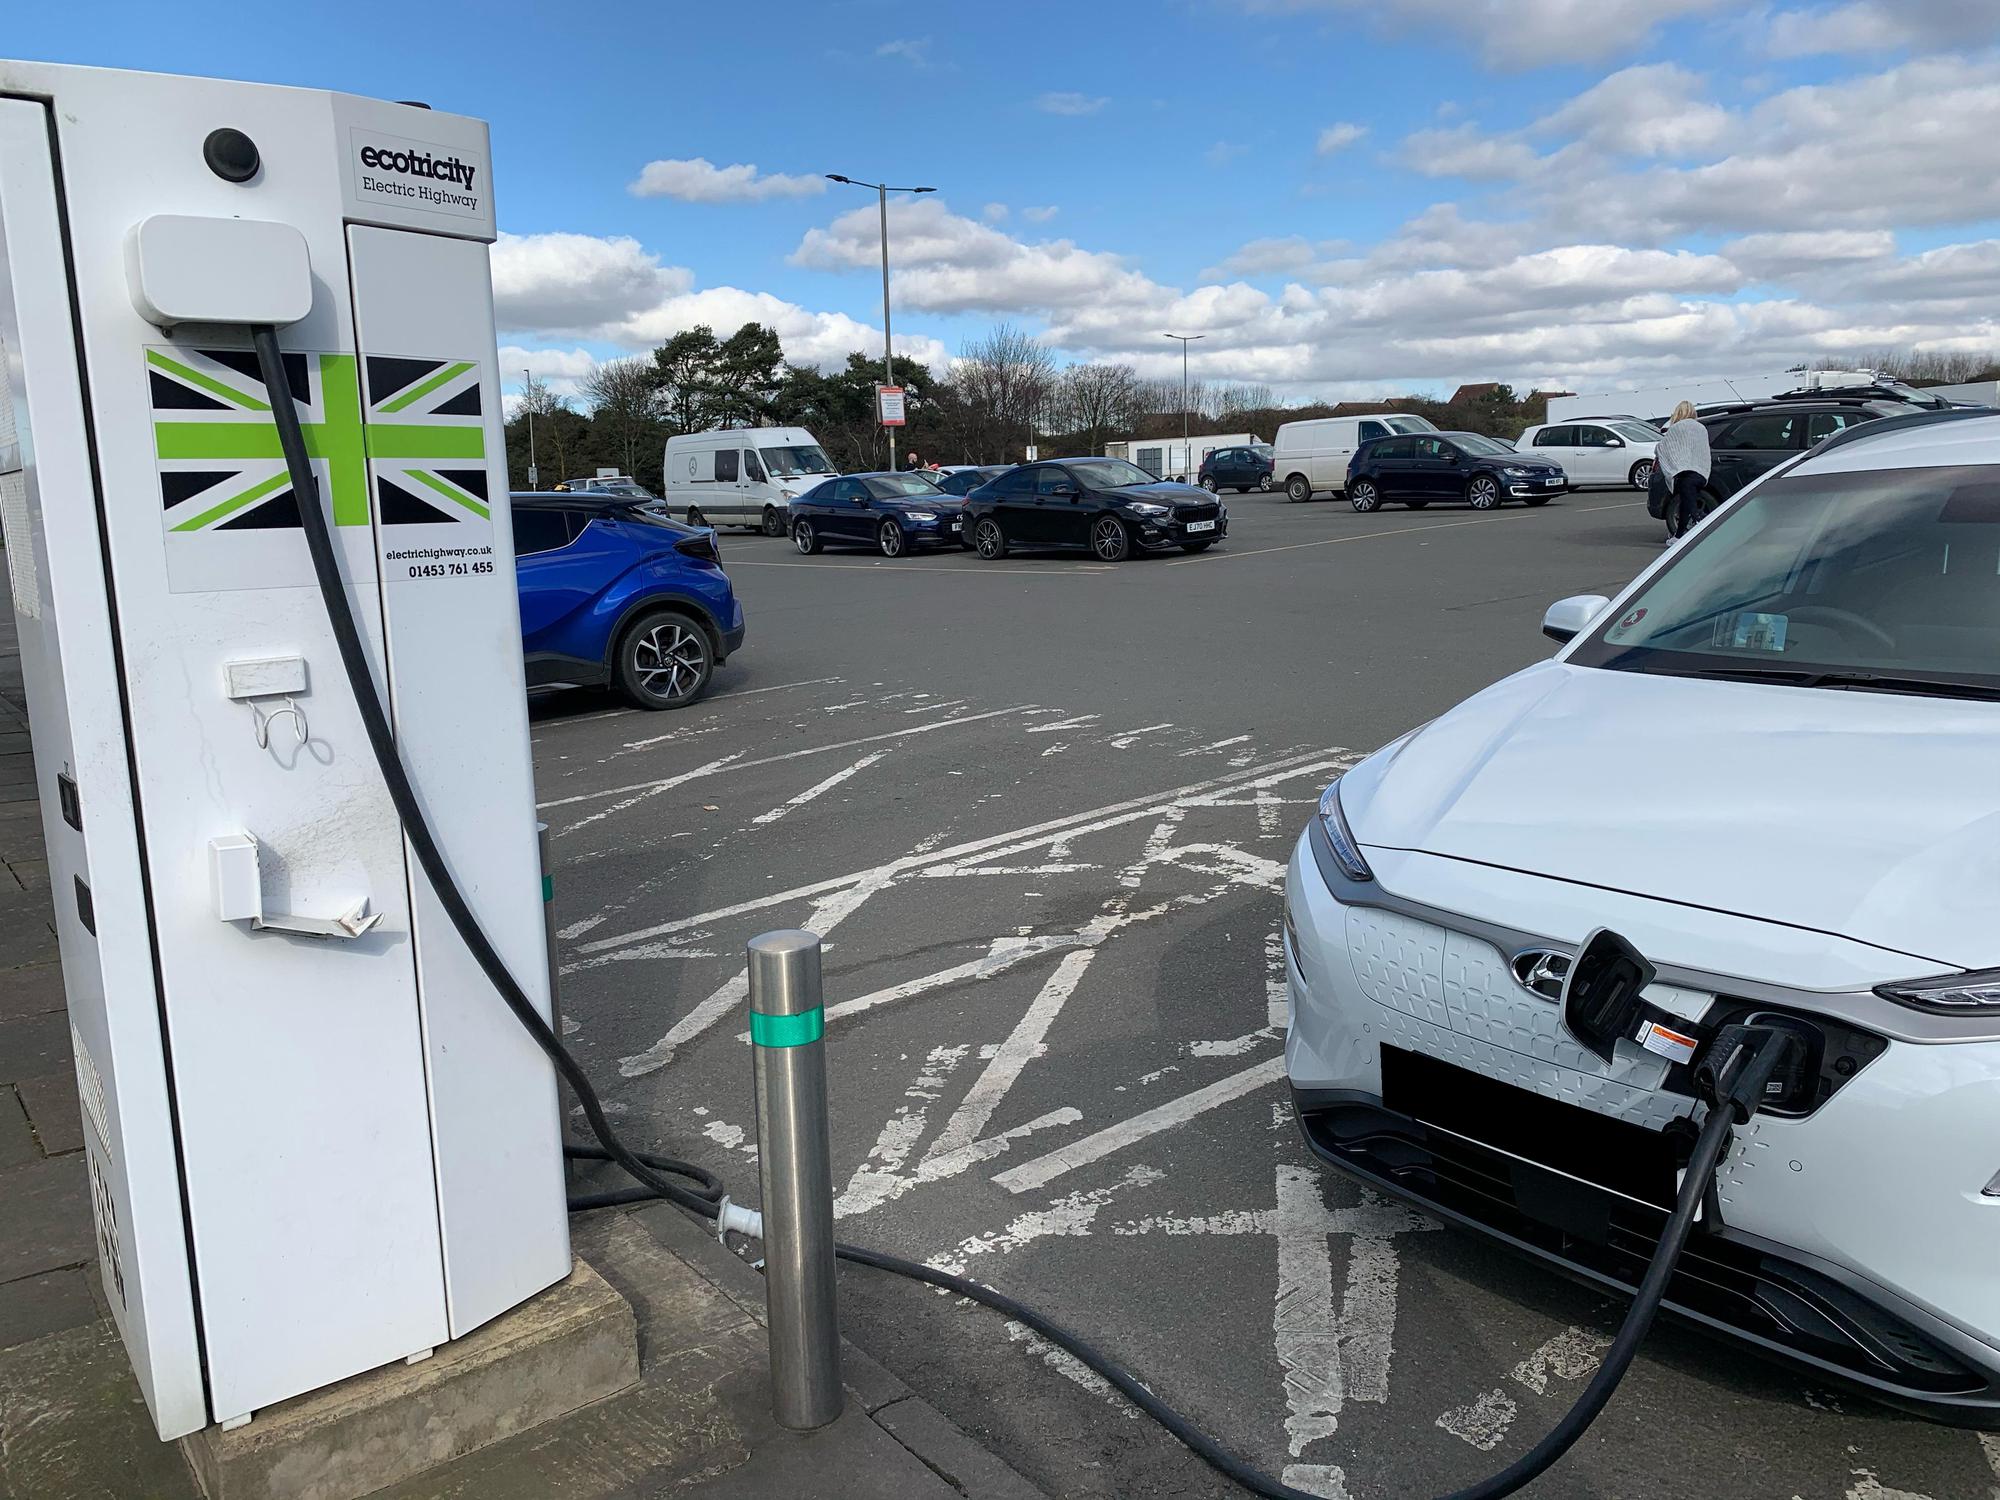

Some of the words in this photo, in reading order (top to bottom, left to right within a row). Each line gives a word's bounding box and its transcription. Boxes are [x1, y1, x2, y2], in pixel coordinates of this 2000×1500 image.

[361, 146, 475, 191] ecotricity
[362, 176, 415, 197] Electric
[418, 186, 477, 210] Highway
[386, 546, 492, 560] electrichighway.co.uk
[409, 564, 445, 578] 01453
[449, 563, 468, 575] 761
[472, 561, 493, 573] 455
